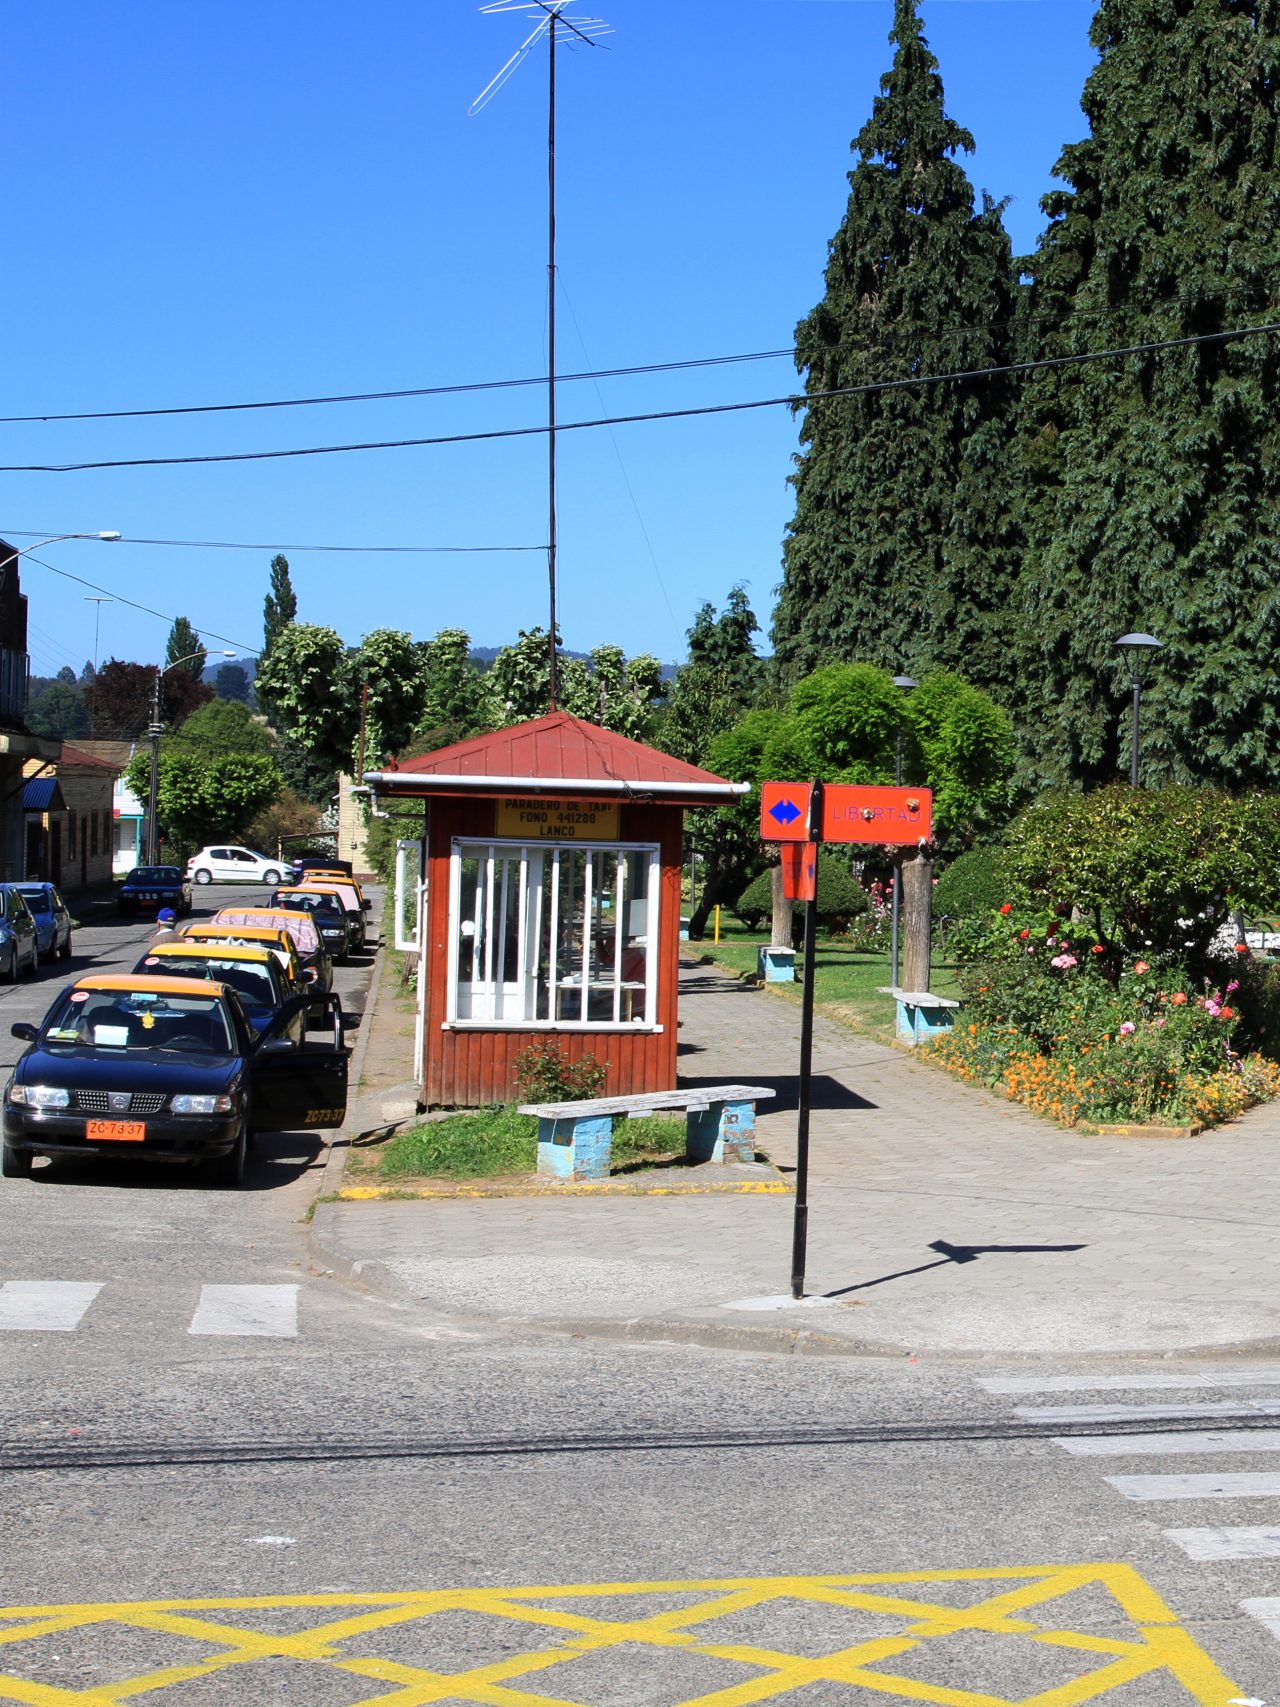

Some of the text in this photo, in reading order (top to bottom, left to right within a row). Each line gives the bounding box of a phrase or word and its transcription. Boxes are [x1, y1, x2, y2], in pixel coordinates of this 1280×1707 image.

[505, 799, 560, 811] PARADERO
[567, 801, 581, 811] DE
[520, 812, 548, 823] FONO
[833, 806, 921, 823] LIBRTAD
[540, 826, 575, 837] LANCO
